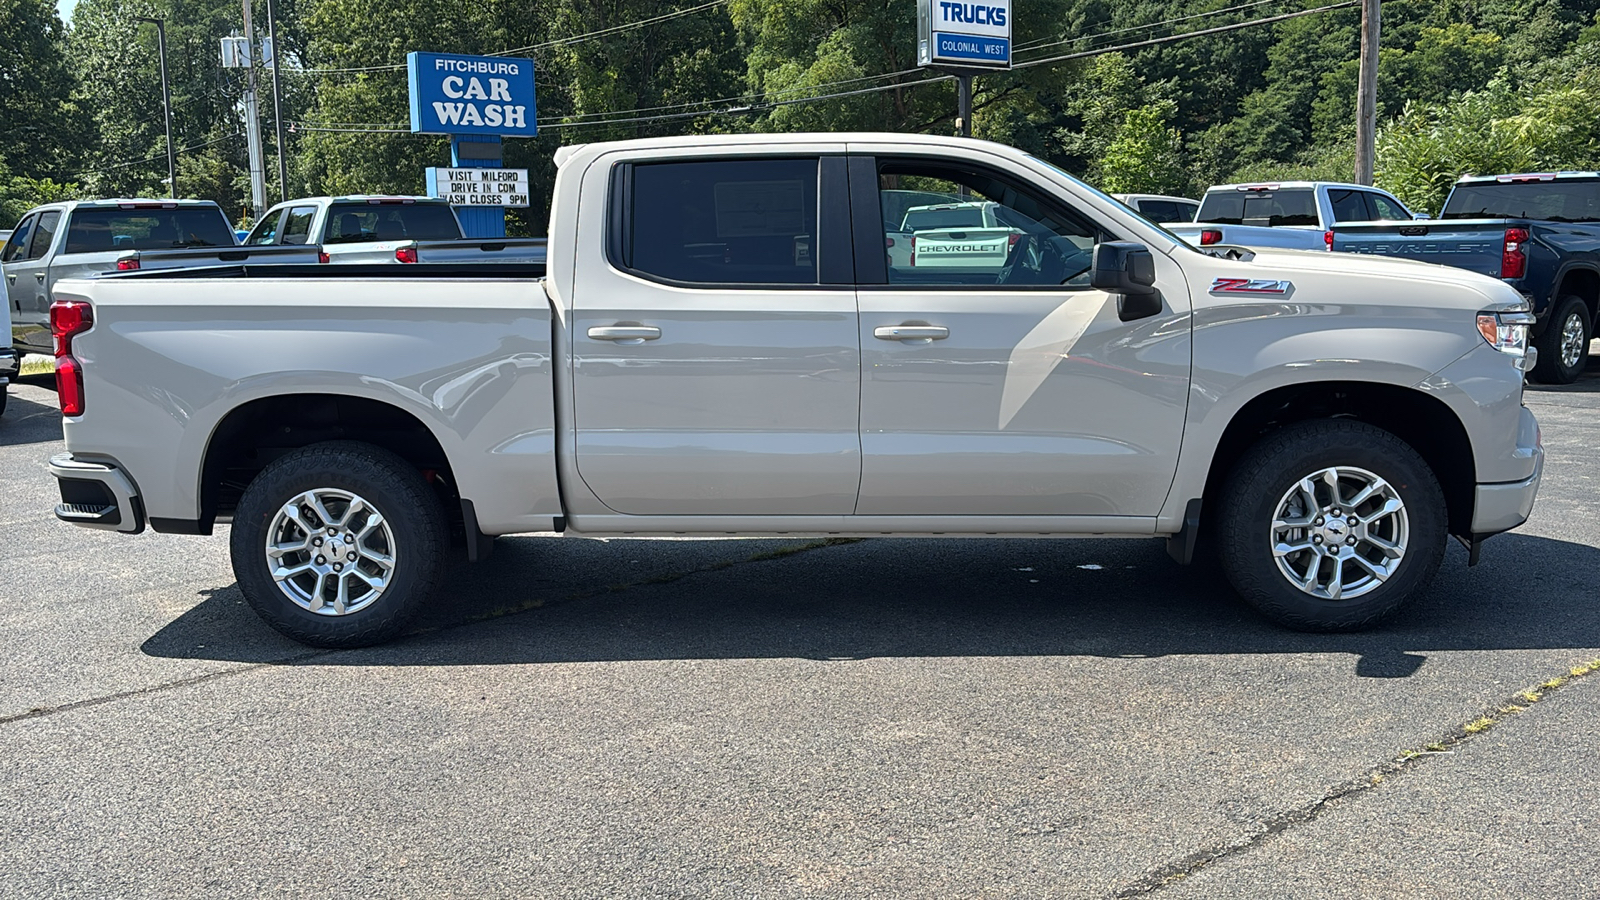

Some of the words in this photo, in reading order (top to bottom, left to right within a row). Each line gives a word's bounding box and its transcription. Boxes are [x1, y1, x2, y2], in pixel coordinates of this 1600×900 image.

[940, 1, 1006, 27] TRUCKS
[942, 40, 980, 54] COLONIAL
[984, 44, 1005, 55] WEST
[435, 59, 519, 75] FITCHBURG
[442, 75, 512, 102] CAR
[432, 101, 527, 128] WASH
[448, 170, 473, 181] VISIT
[481, 171, 518, 182] MILFORD
[451, 182, 478, 193] DRIVE
[482, 183, 491, 193] IN
[497, 183, 516, 193] COM
[469, 194, 502, 205] CLOSES
[509, 194, 527, 205] 9PM
[919, 244, 999, 253] CHEVROLET
[1207, 276, 1290, 294] Z71
